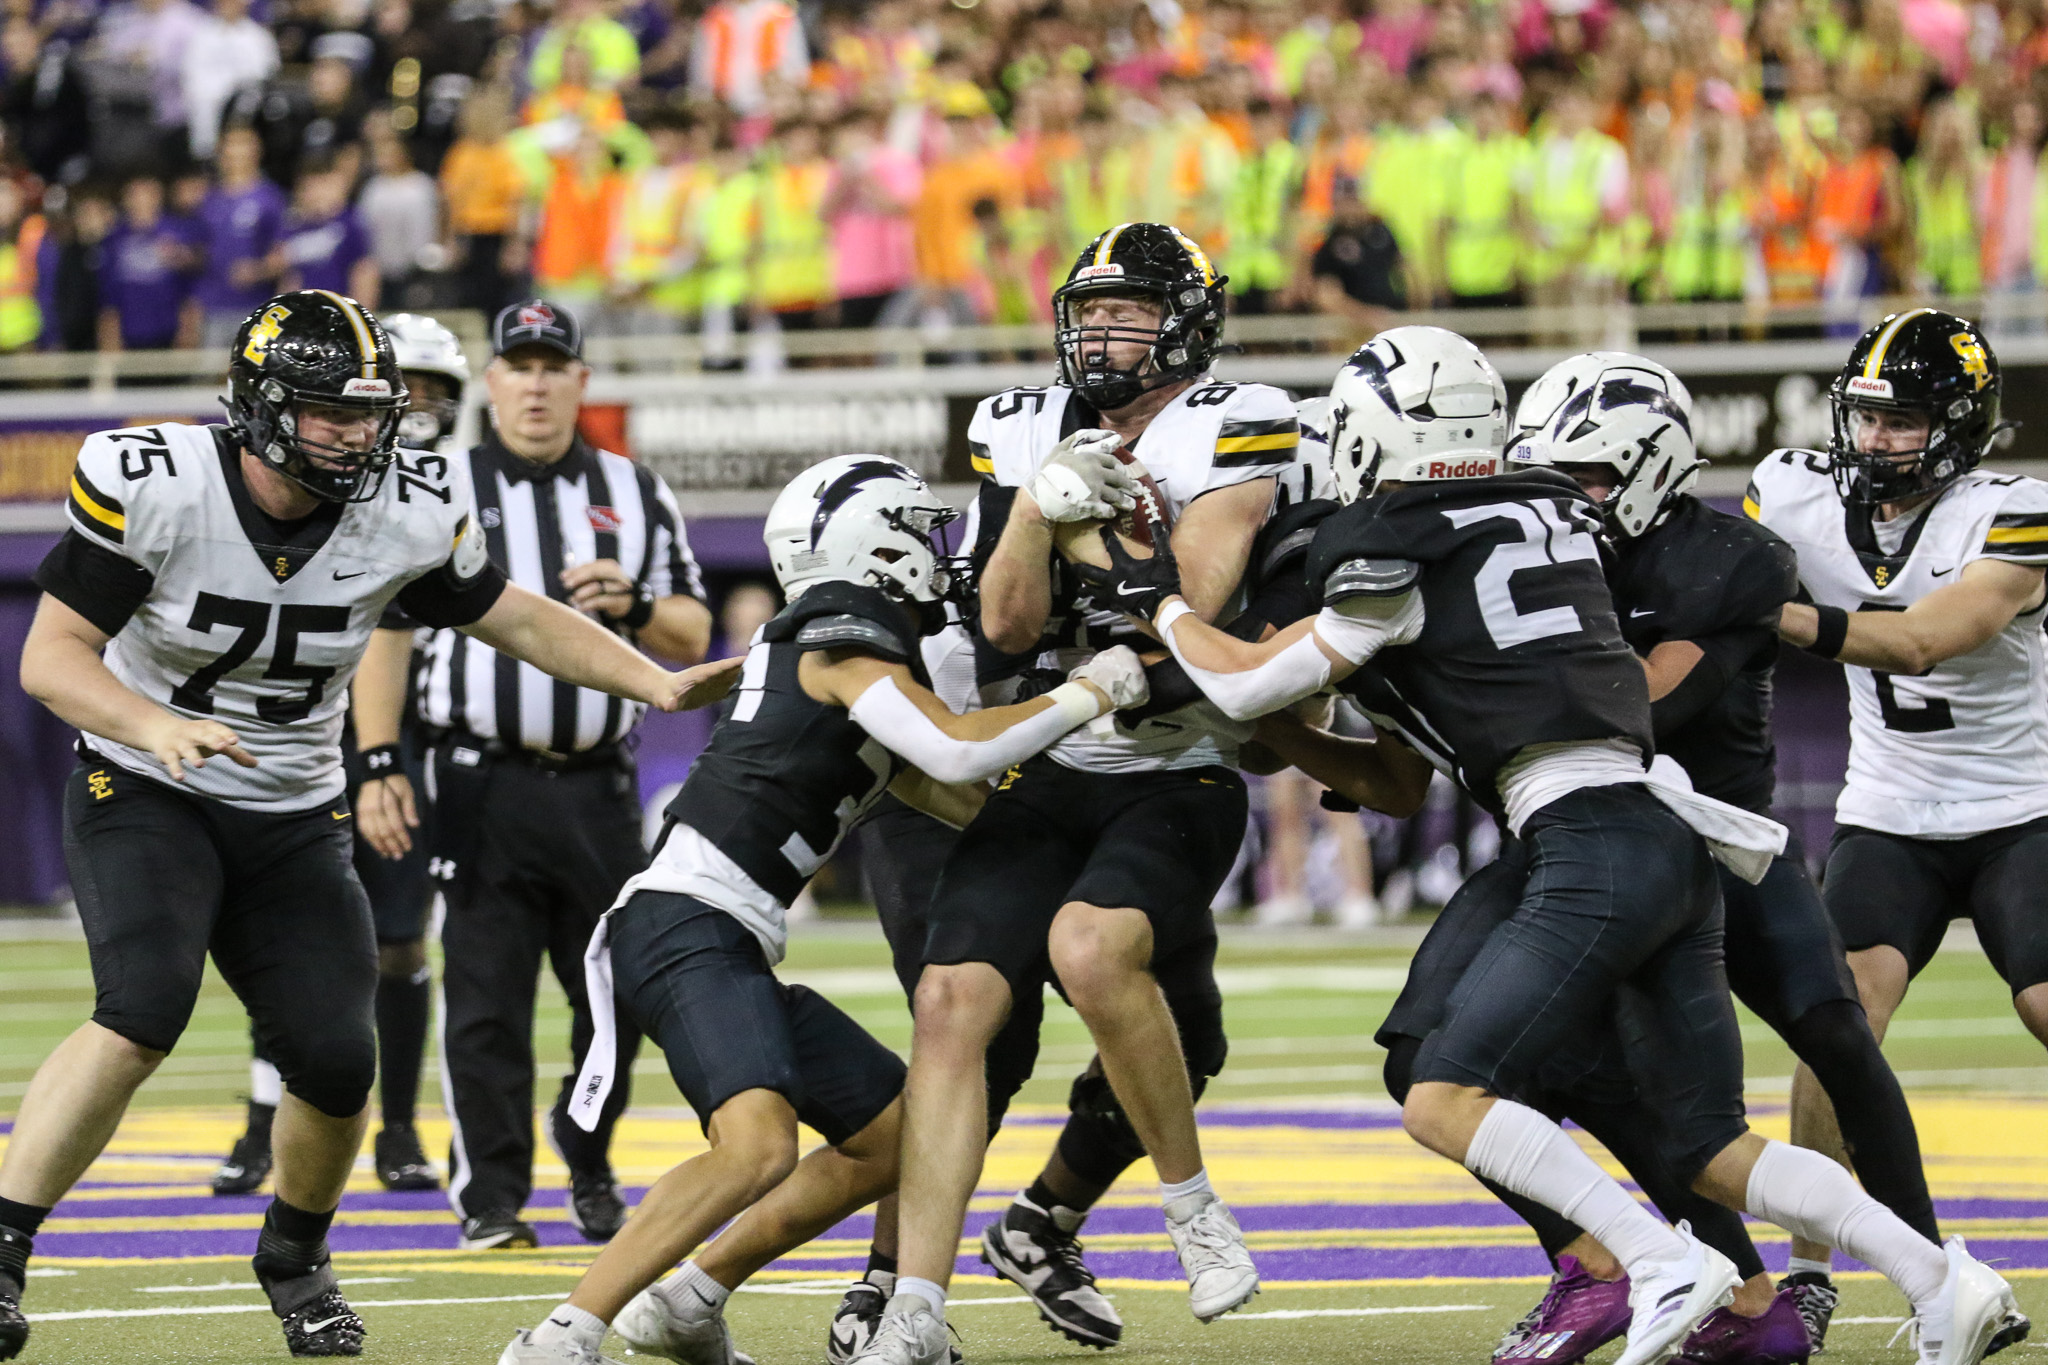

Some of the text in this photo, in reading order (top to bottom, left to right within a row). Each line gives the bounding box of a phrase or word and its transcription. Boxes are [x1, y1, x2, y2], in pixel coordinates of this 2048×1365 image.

[1852, 379, 1887, 393] Riddell
[107, 428, 178, 482] 75
[1516, 445, 1532, 460] 319
[1780, 450, 1834, 476] 2
[397, 454, 452, 505] 75
[1428, 459, 1497, 479] Riddell
[170, 590, 353, 725] 75
